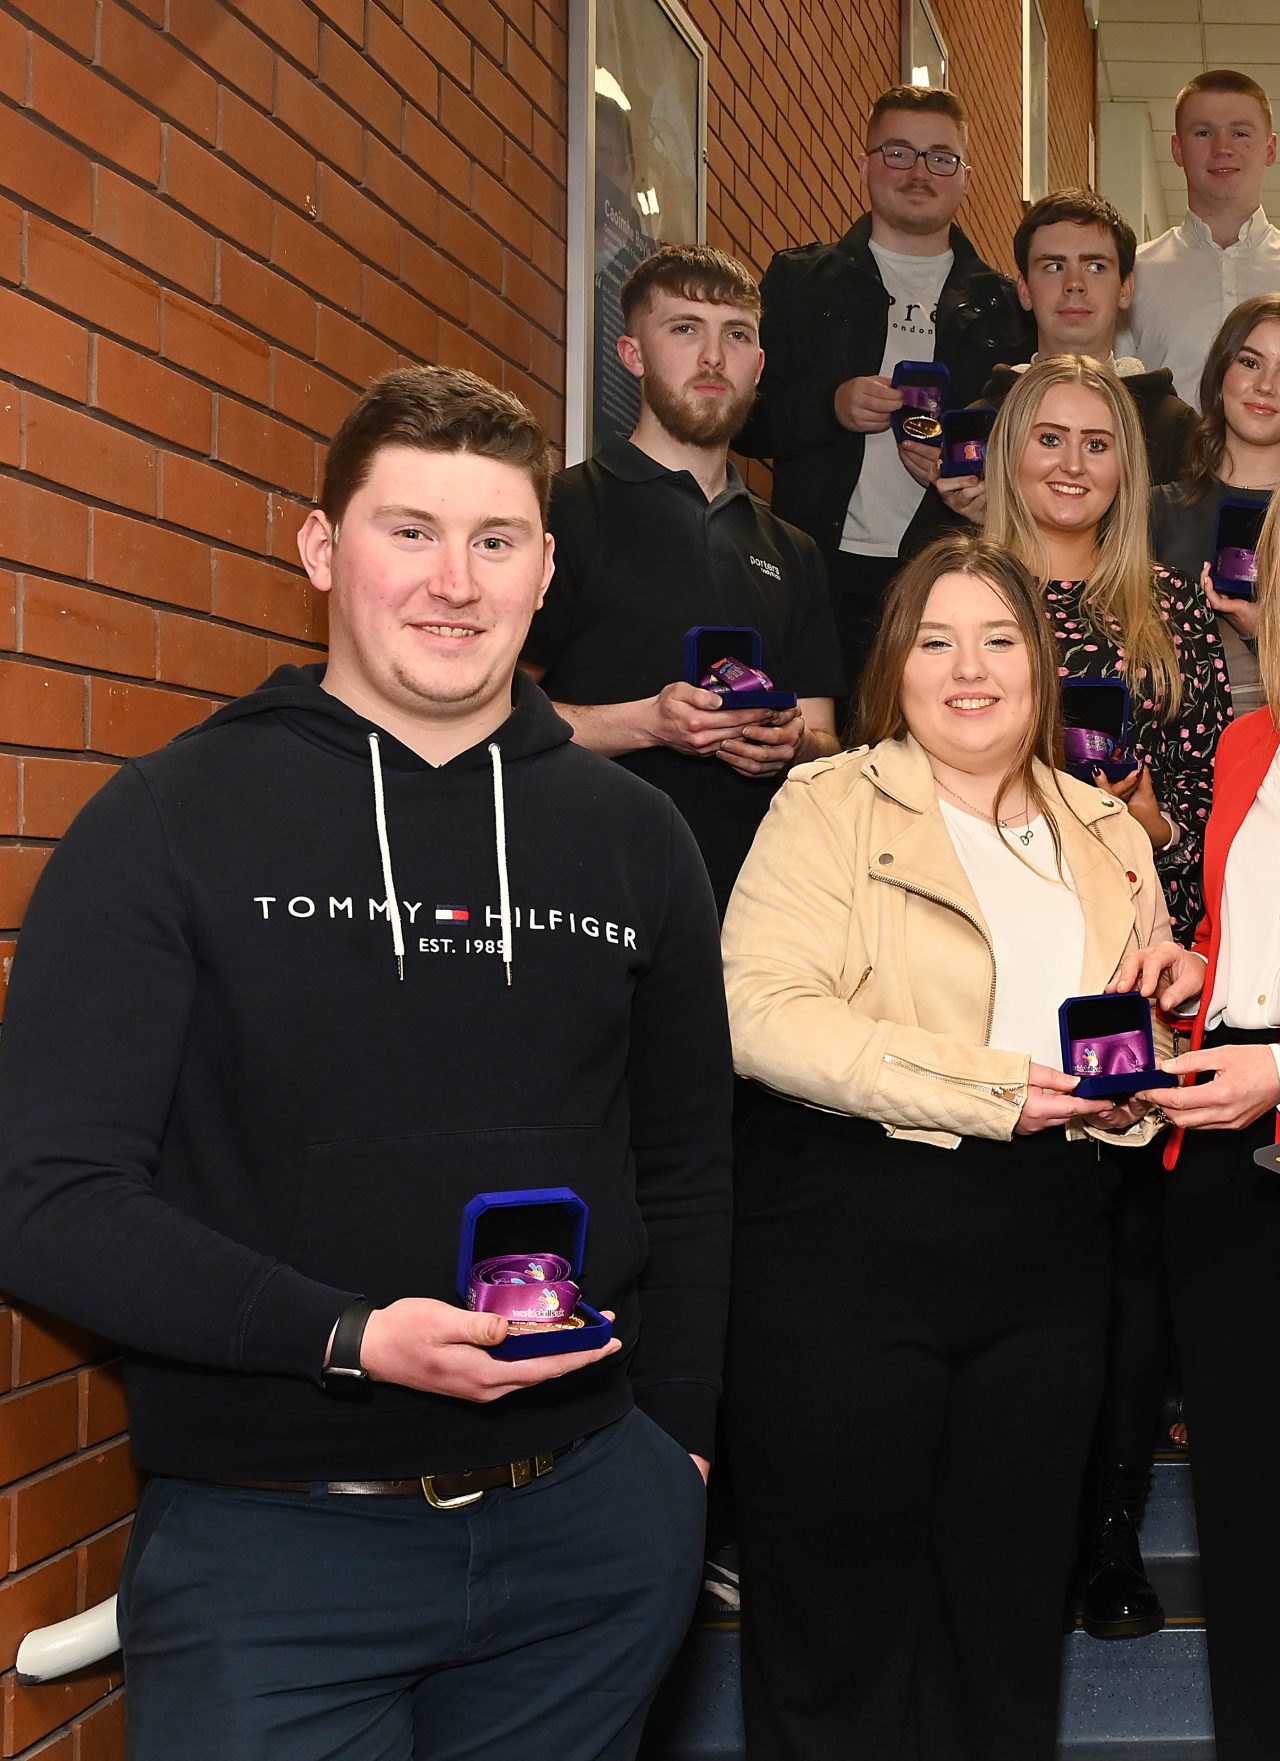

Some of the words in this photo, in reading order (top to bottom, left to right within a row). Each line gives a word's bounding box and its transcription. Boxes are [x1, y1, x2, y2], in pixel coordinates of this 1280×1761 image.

[750, 555, 780, 575] porters
[253, 896, 422, 924] TOMMY
[485, 905, 638, 951] HILFIGER
[419, 937, 456, 954] EST.
[464, 938, 505, 955] 1985
